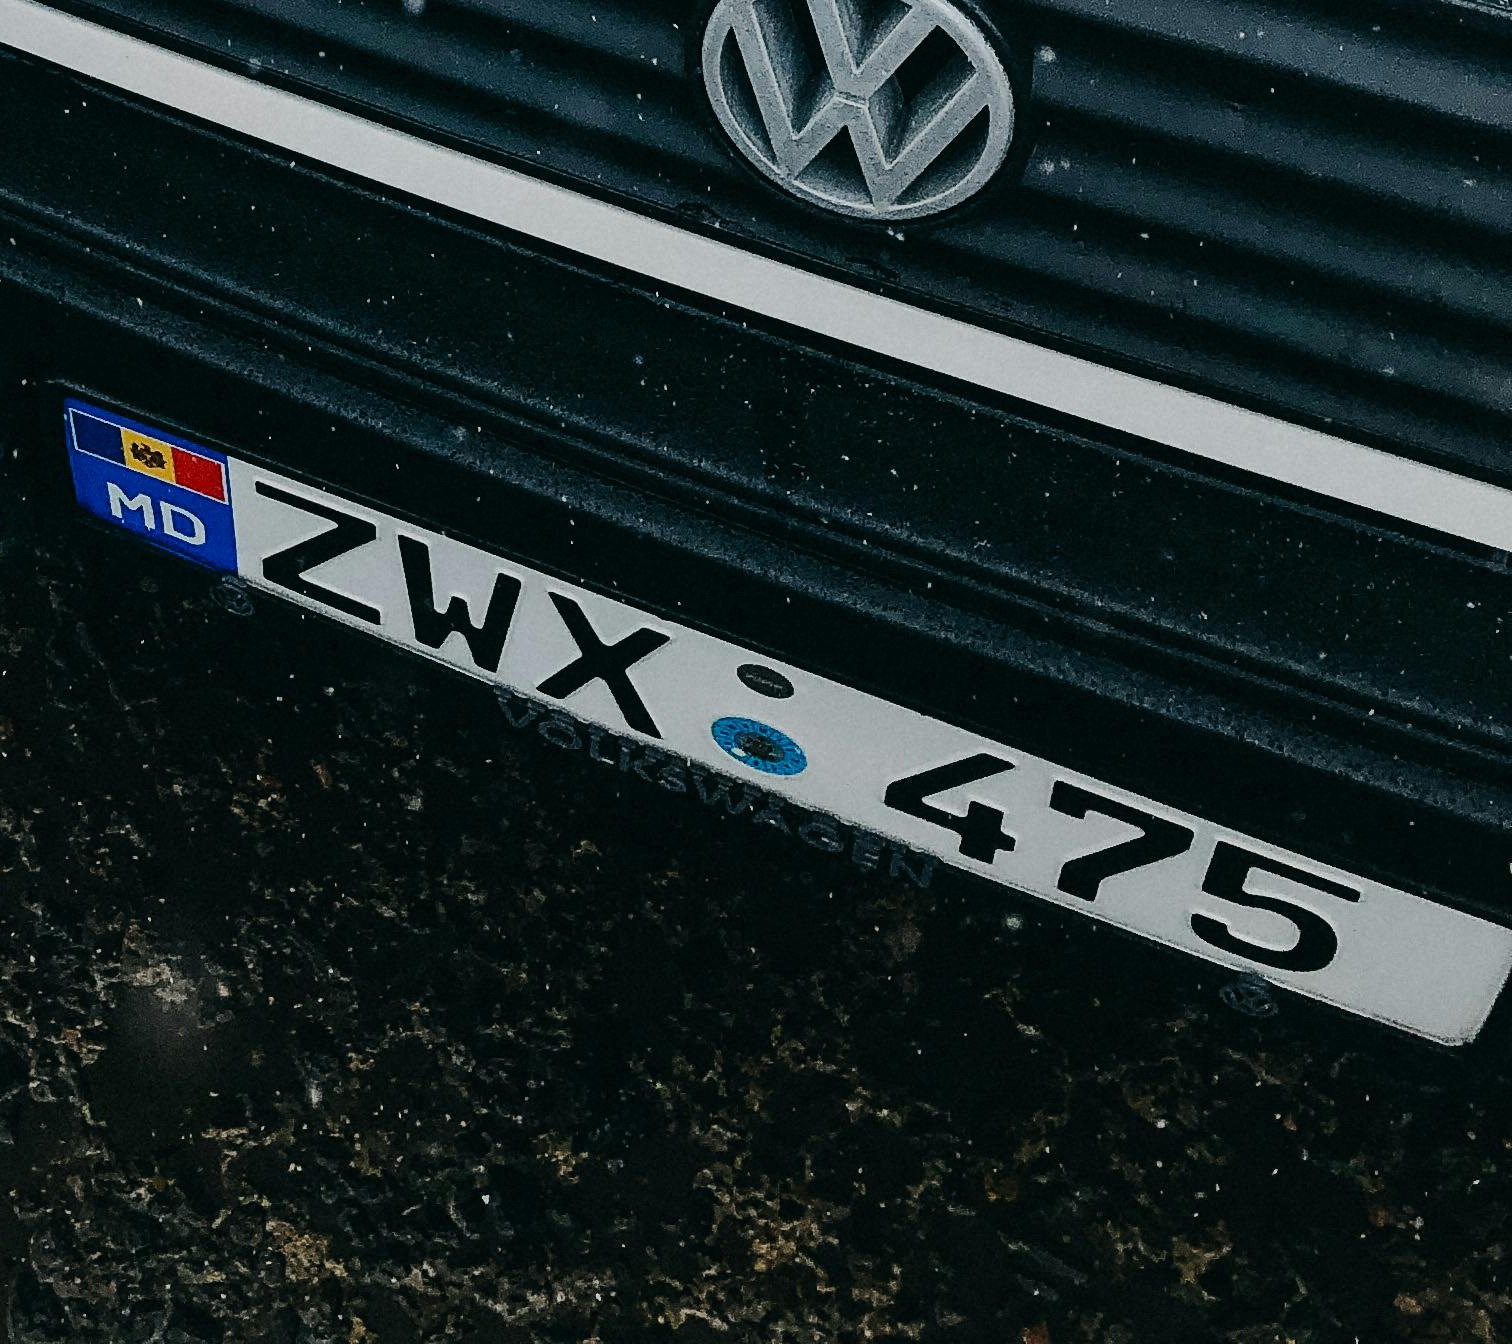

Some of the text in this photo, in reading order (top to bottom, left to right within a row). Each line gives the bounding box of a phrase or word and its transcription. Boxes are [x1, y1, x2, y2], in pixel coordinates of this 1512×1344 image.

[106, 480, 207, 547] MD
[254, 480, 1361, 973] ZWX 475
